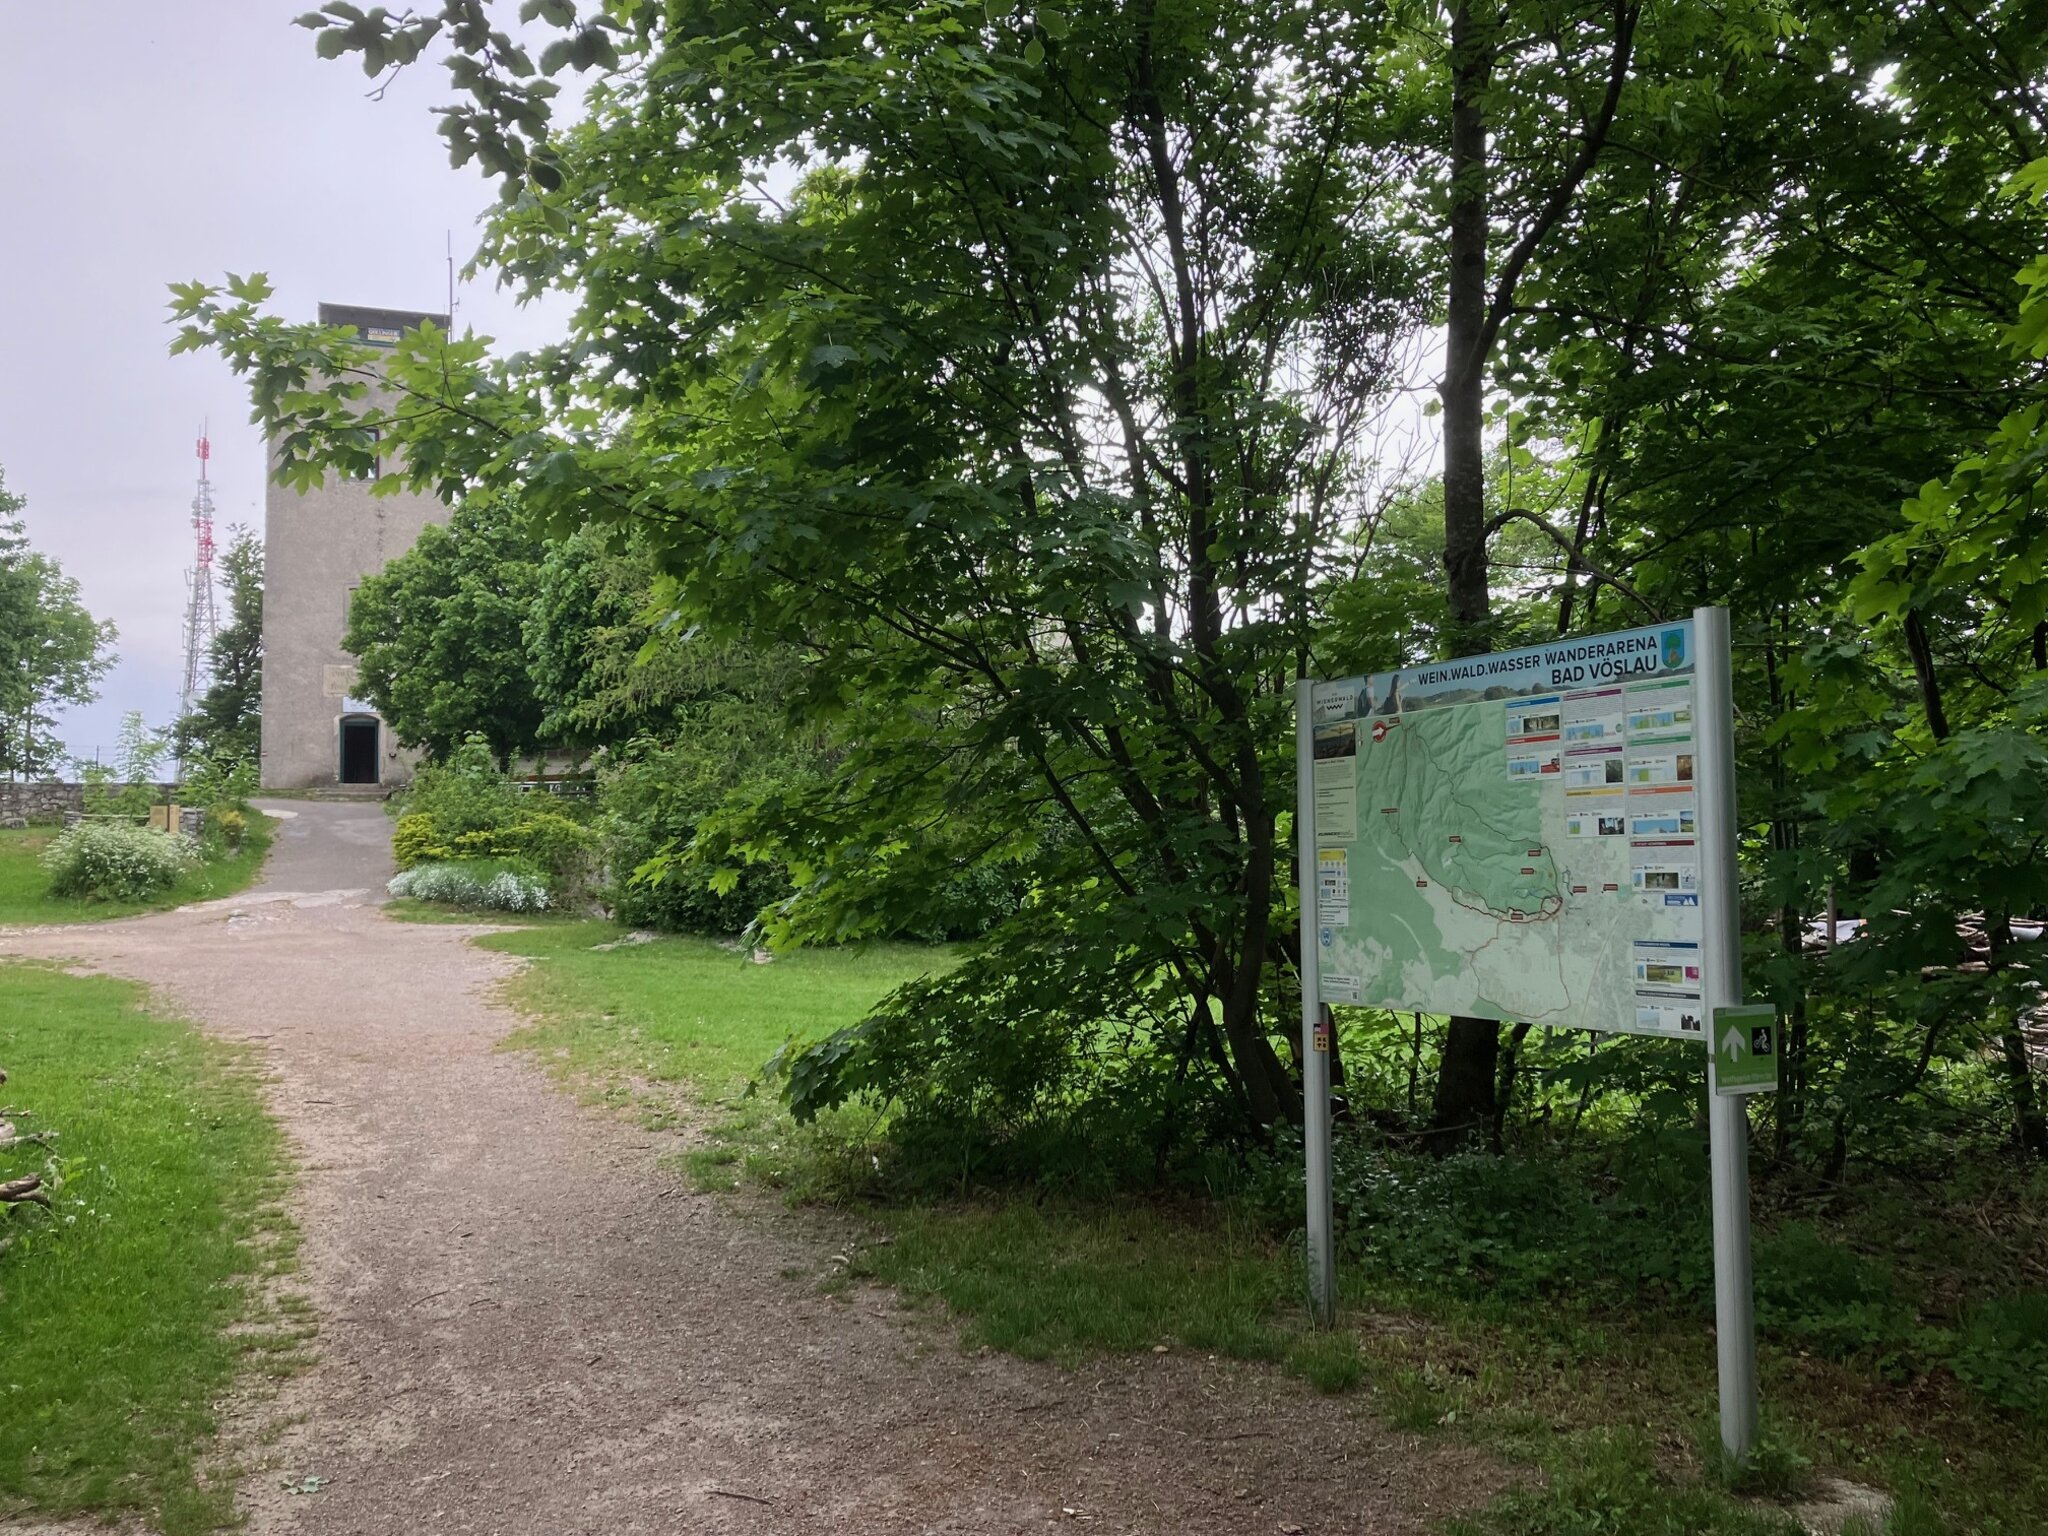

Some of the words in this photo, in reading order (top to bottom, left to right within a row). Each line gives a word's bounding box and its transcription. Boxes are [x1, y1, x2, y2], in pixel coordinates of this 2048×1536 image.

[1418, 654, 1540, 685] WEIN.WALD.WASSER
[1545, 636, 1657, 664] WANDERARENA
[1552, 667, 1585, 685] BAD
[1589, 654, 1657, 679] VÖSLAU
